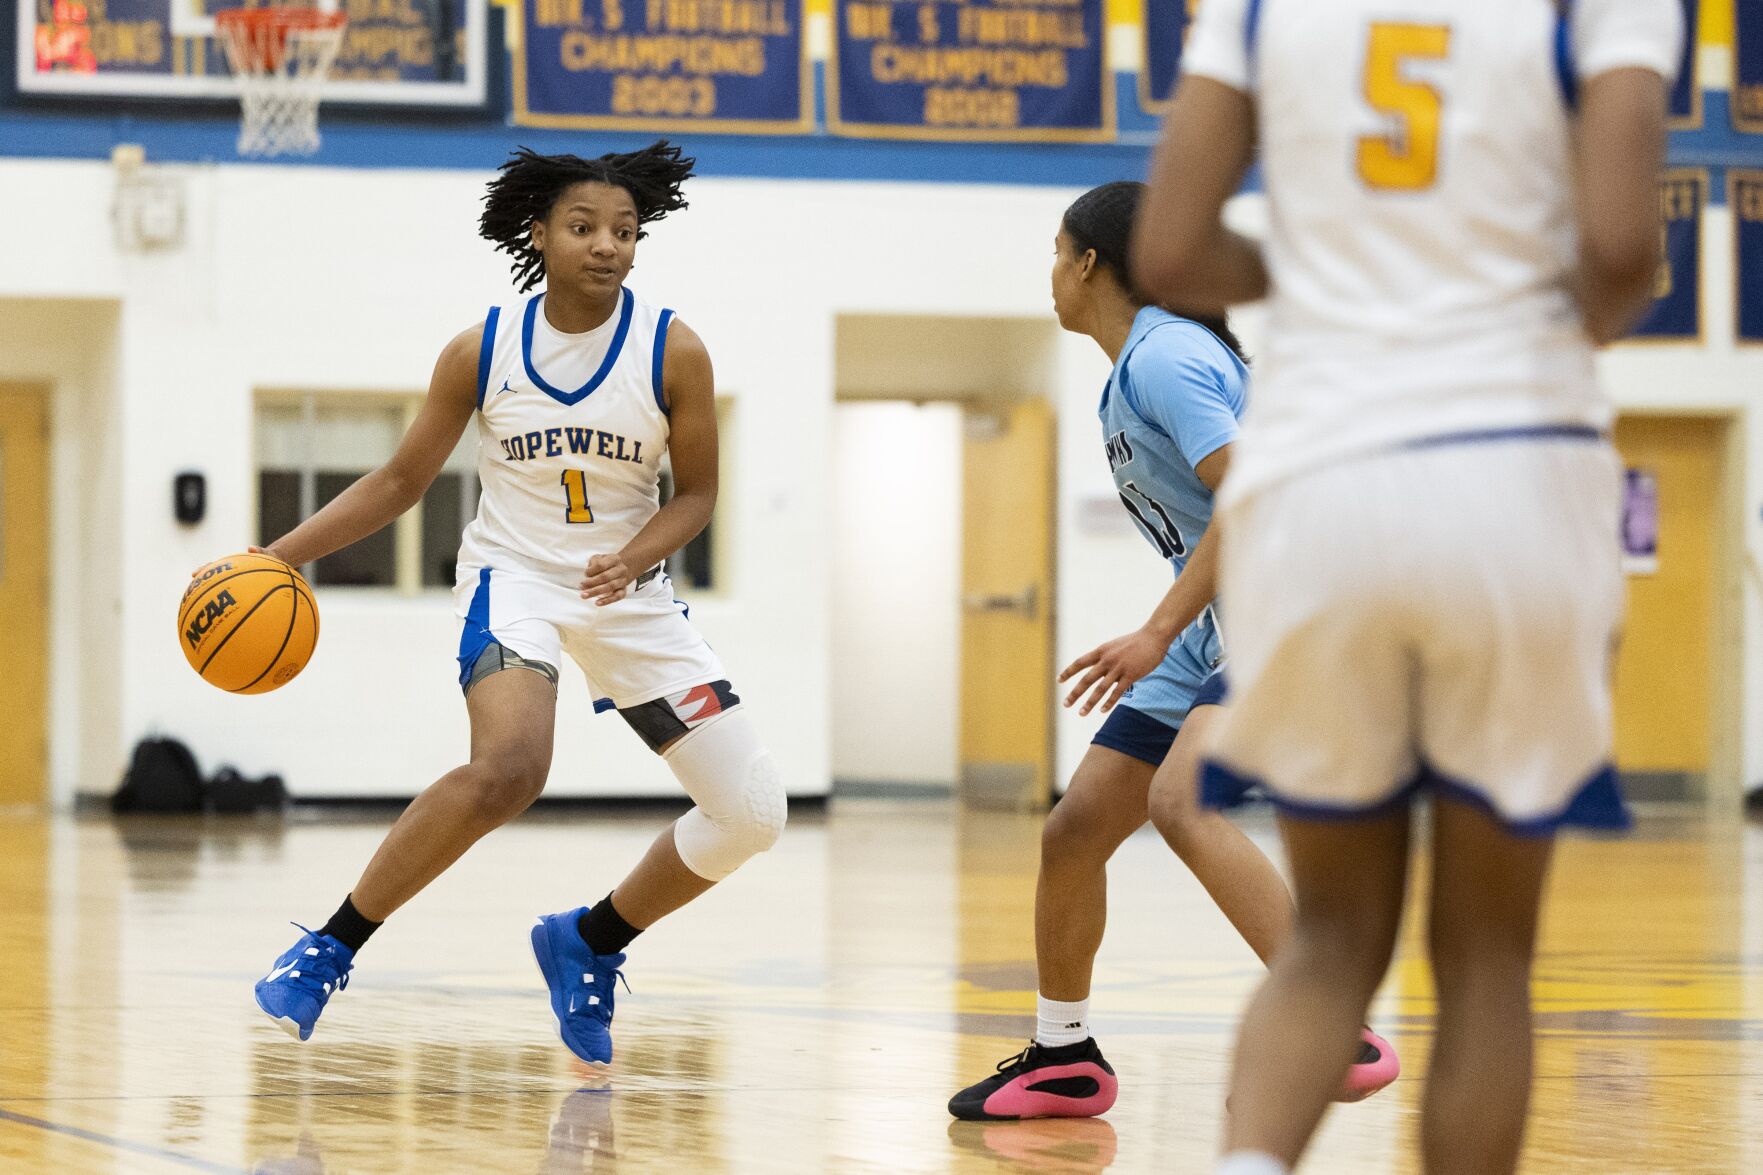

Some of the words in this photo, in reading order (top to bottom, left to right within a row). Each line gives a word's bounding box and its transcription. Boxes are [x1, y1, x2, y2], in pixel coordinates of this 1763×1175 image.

[560, 30, 765, 77] CHAMPIONS
[870, 45, 1068, 88] CHAMPIONS
[611, 75, 717, 116] 2003
[1355, 19, 1453, 191] 5
[500, 427, 643, 464] HOPEWELL
[560, 468, 595, 524] 1
[185, 589, 238, 651] NCAA
